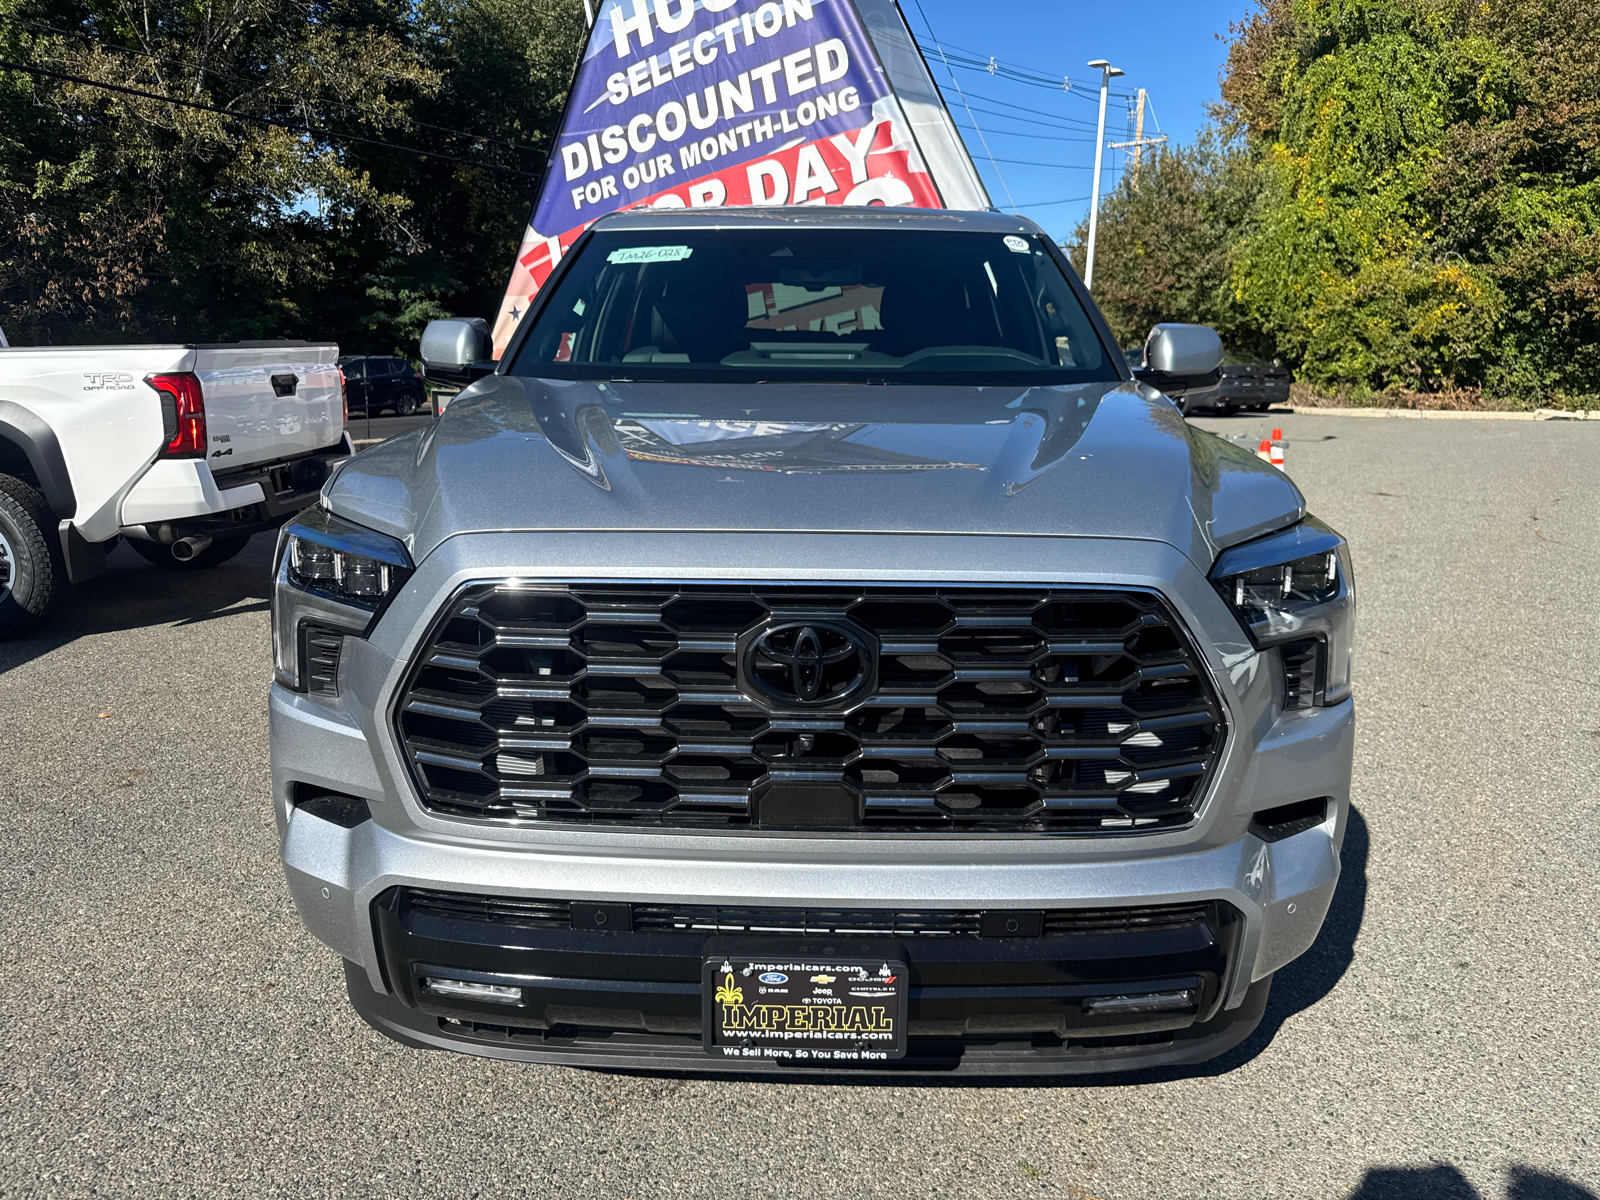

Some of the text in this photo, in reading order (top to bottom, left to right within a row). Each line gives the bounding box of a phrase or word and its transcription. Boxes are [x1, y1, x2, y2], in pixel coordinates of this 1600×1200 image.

[606, 0, 814, 106] SELECTION
[561, 38, 849, 182] DISCOUNTED
[571, 175, 619, 211] FOR
[622, 153, 676, 190] OUR
[679, 86, 861, 170] MONTH-LONG
[746, 122, 881, 208] DAY
[617, 247, 682, 261] TM26-028
[83, 372, 133, 386] TRD
[749, 962, 863, 973] Imperialcars.com
[812, 987, 833, 996] Jeep
[722, 1003, 893, 1032] IMPERIAL
[722, 1030, 893, 1040] www.imperialcars.com
[723, 1047, 887, 1060] We Sell More, So You Save More
